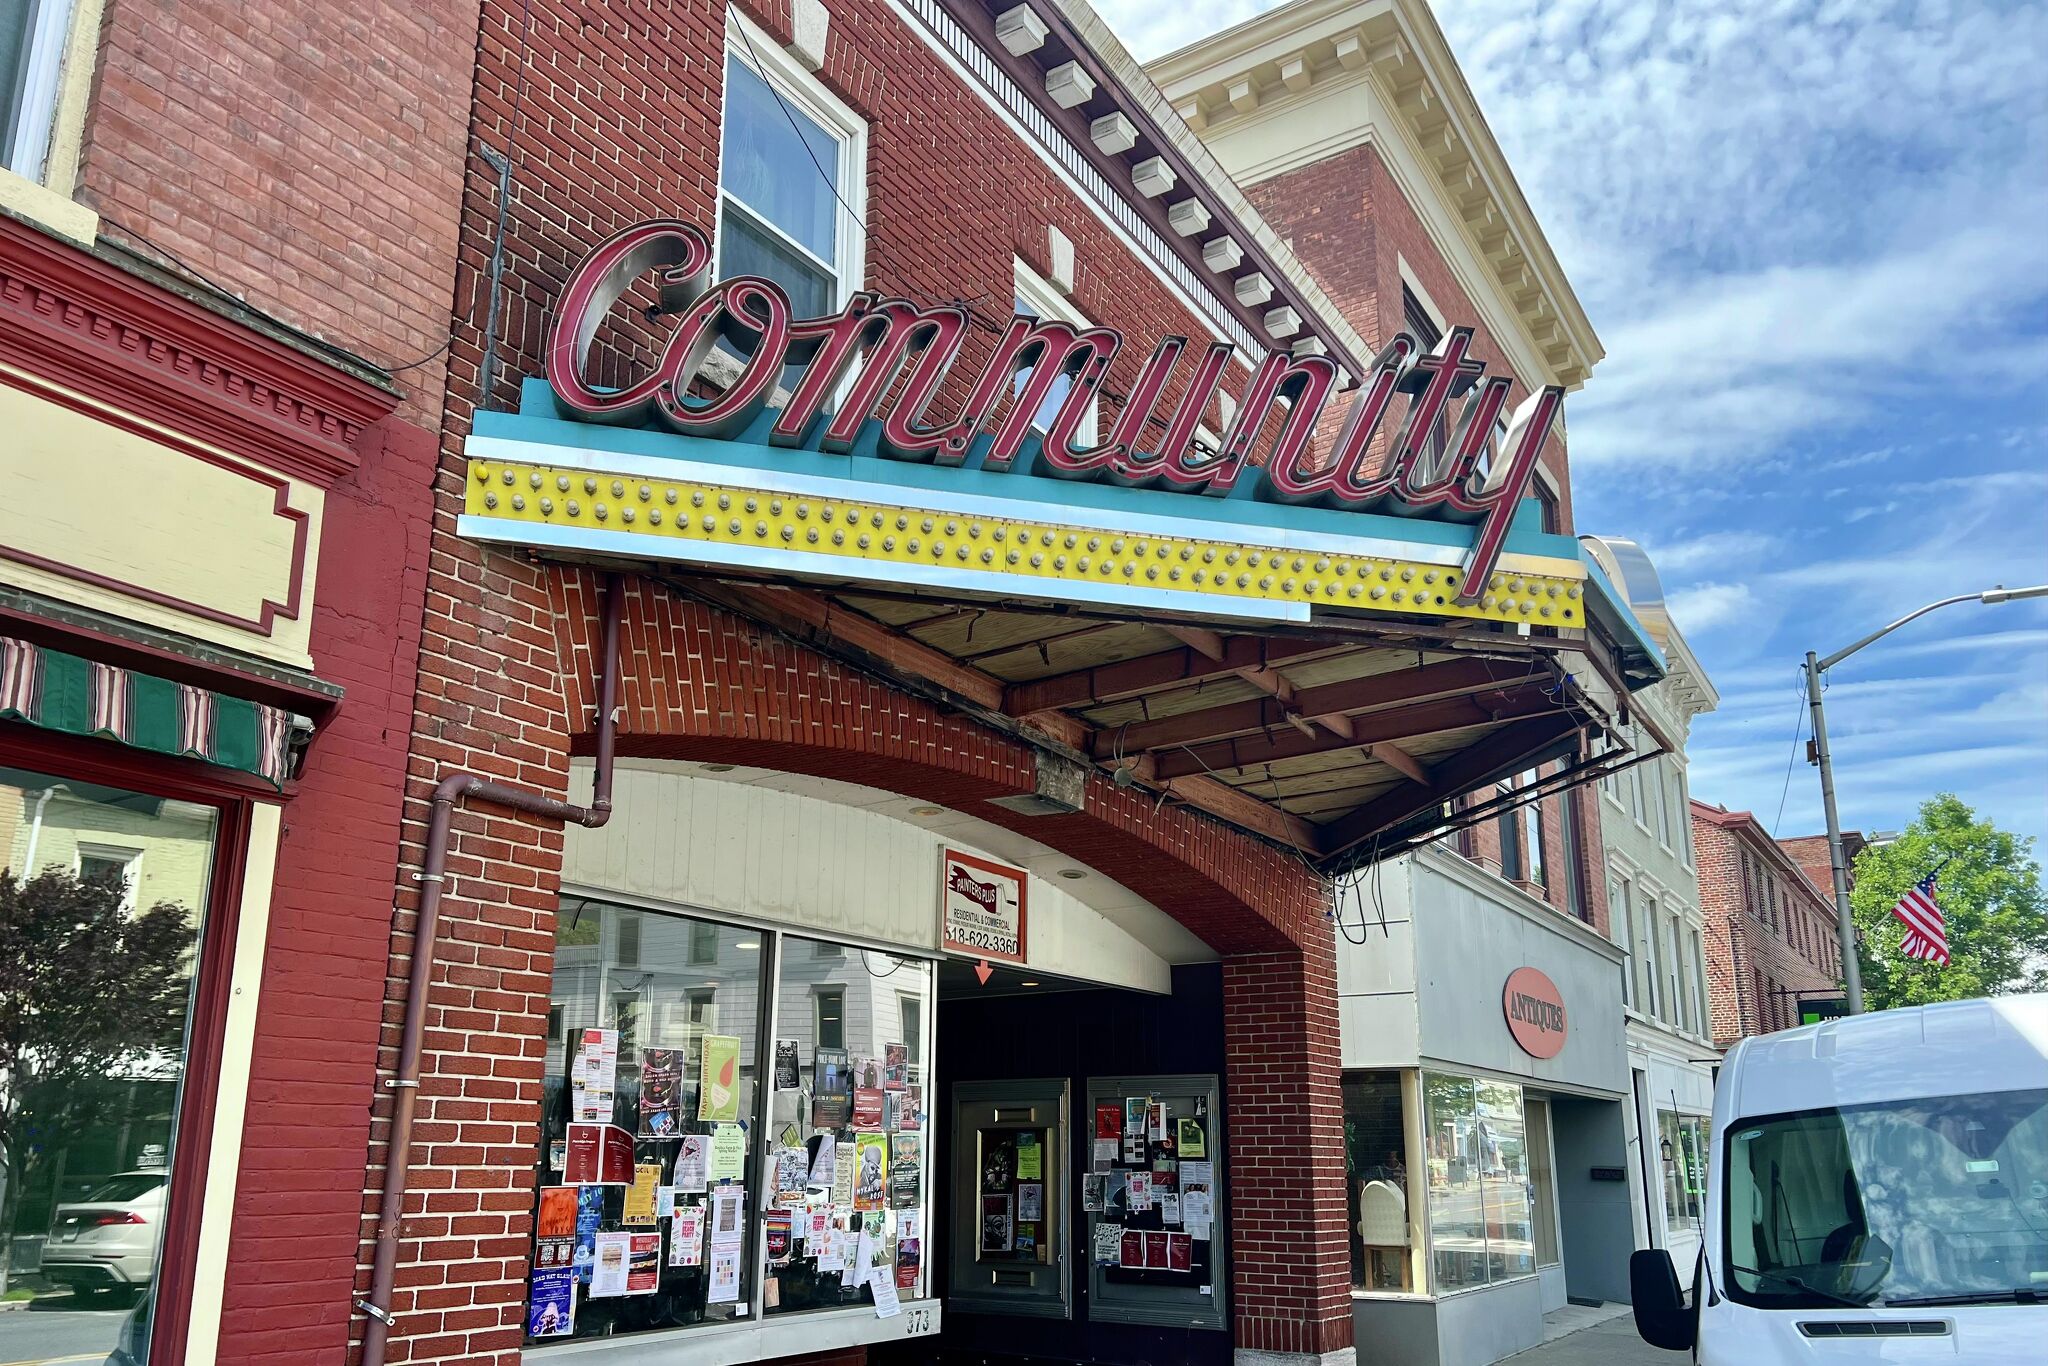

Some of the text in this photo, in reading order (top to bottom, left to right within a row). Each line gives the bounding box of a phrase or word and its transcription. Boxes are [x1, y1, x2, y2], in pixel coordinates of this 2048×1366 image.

[543, 217, 1565, 606] Community
[956, 878, 996, 903] PAINTERS PLUS
[953, 908, 981, 924] RESIDENTIAL
[984, 916, 1010, 931] COMMERCIAL
[1510, 990, 1564, 1033] ANTIQUES
[700, 1038, 711, 1117] HAPPY BIRTHDAY
[906, 1310, 930, 1334] 373
